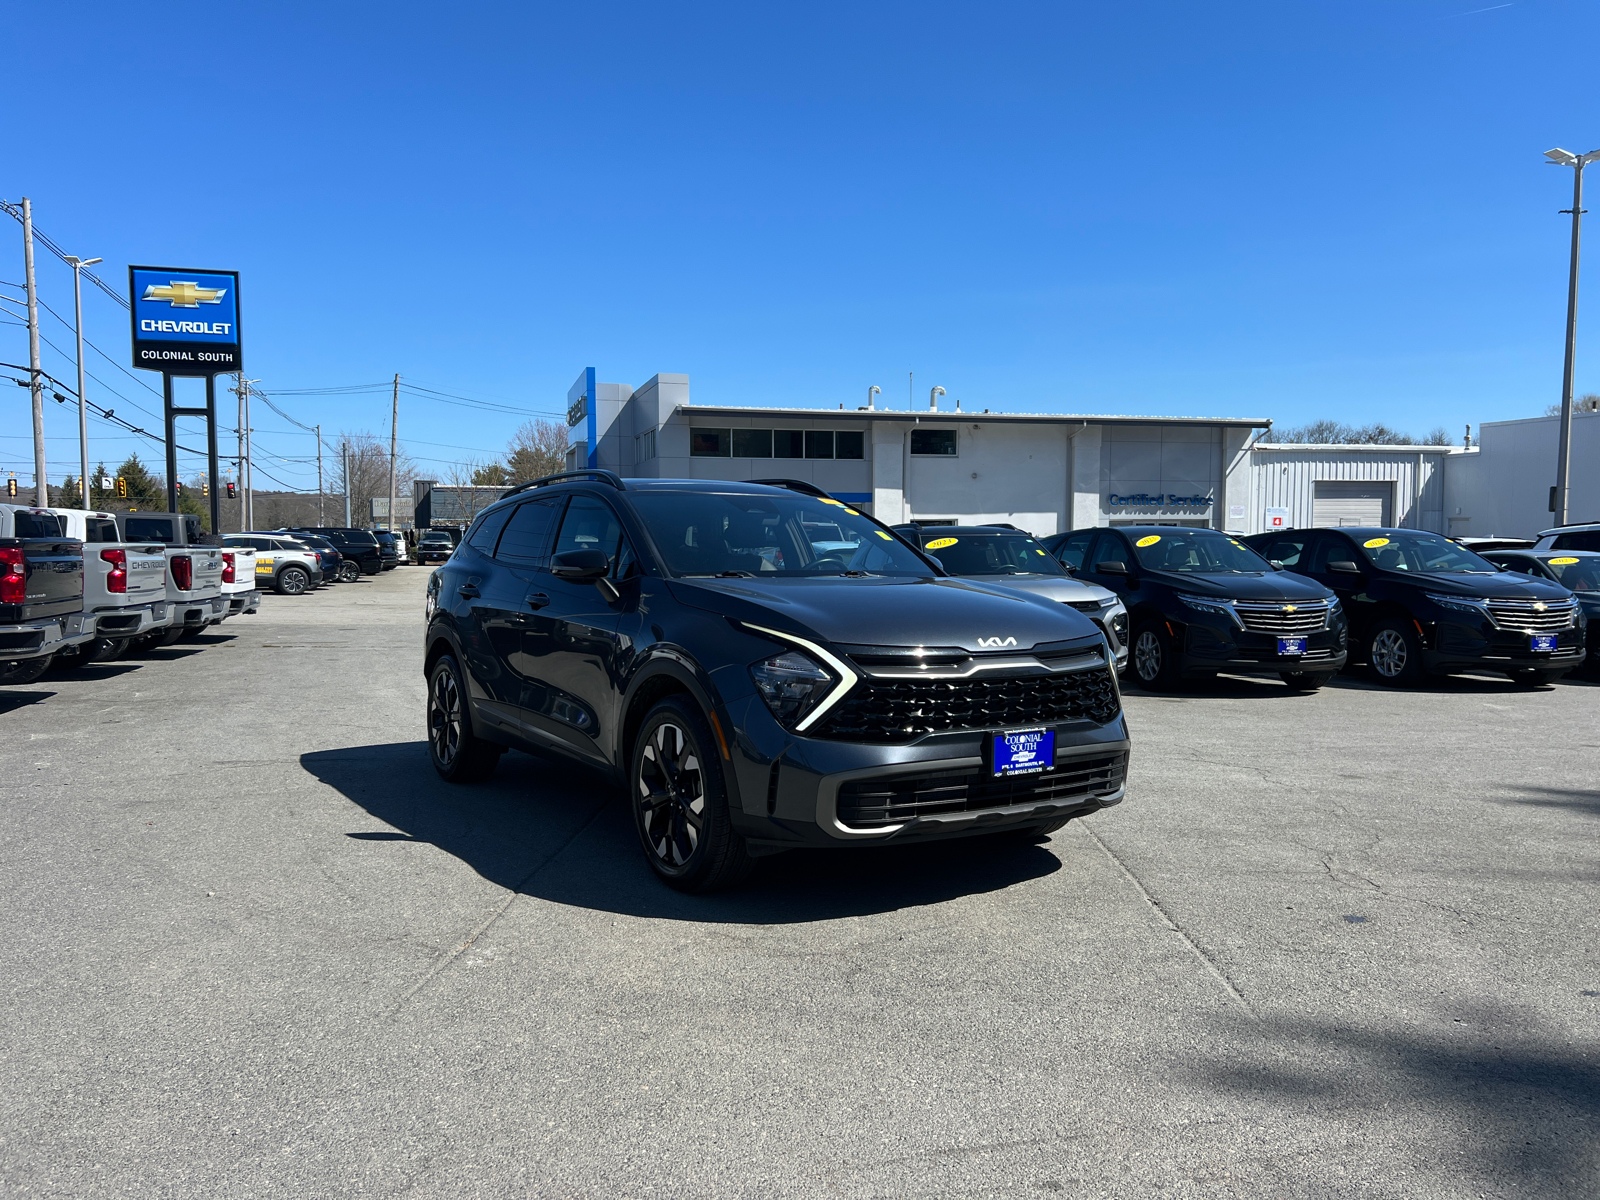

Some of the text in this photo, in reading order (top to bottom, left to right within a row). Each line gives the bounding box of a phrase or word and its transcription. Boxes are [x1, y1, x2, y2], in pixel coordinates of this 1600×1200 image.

[141, 319, 231, 335] CHEVROLET
[141, 350, 233, 362] COLONIAL SOUTH
[1109, 493, 1214, 507] Certified Service
[132, 561, 166, 570] CHEVROLE
[977, 636, 1018, 647] KIA
[1005, 733, 1043, 745] COLONIAL
[1010, 742, 1037, 753] SOUTH
